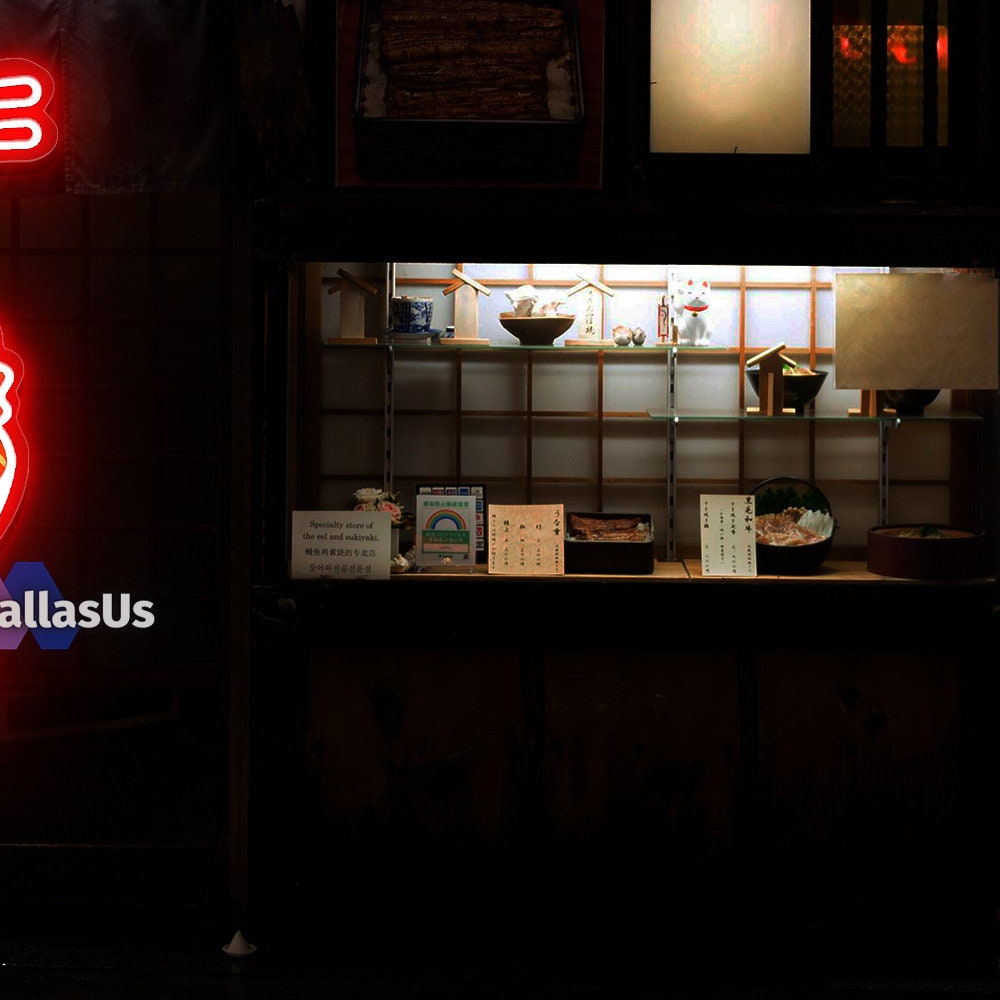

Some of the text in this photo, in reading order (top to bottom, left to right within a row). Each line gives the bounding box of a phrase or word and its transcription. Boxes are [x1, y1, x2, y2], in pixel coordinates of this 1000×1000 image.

[309, 520, 374, 530] Specialty store of
[302, 532, 315, 540] the
[329, 533, 344, 541] and
[345, 533, 380, 542] sukiyaki.
